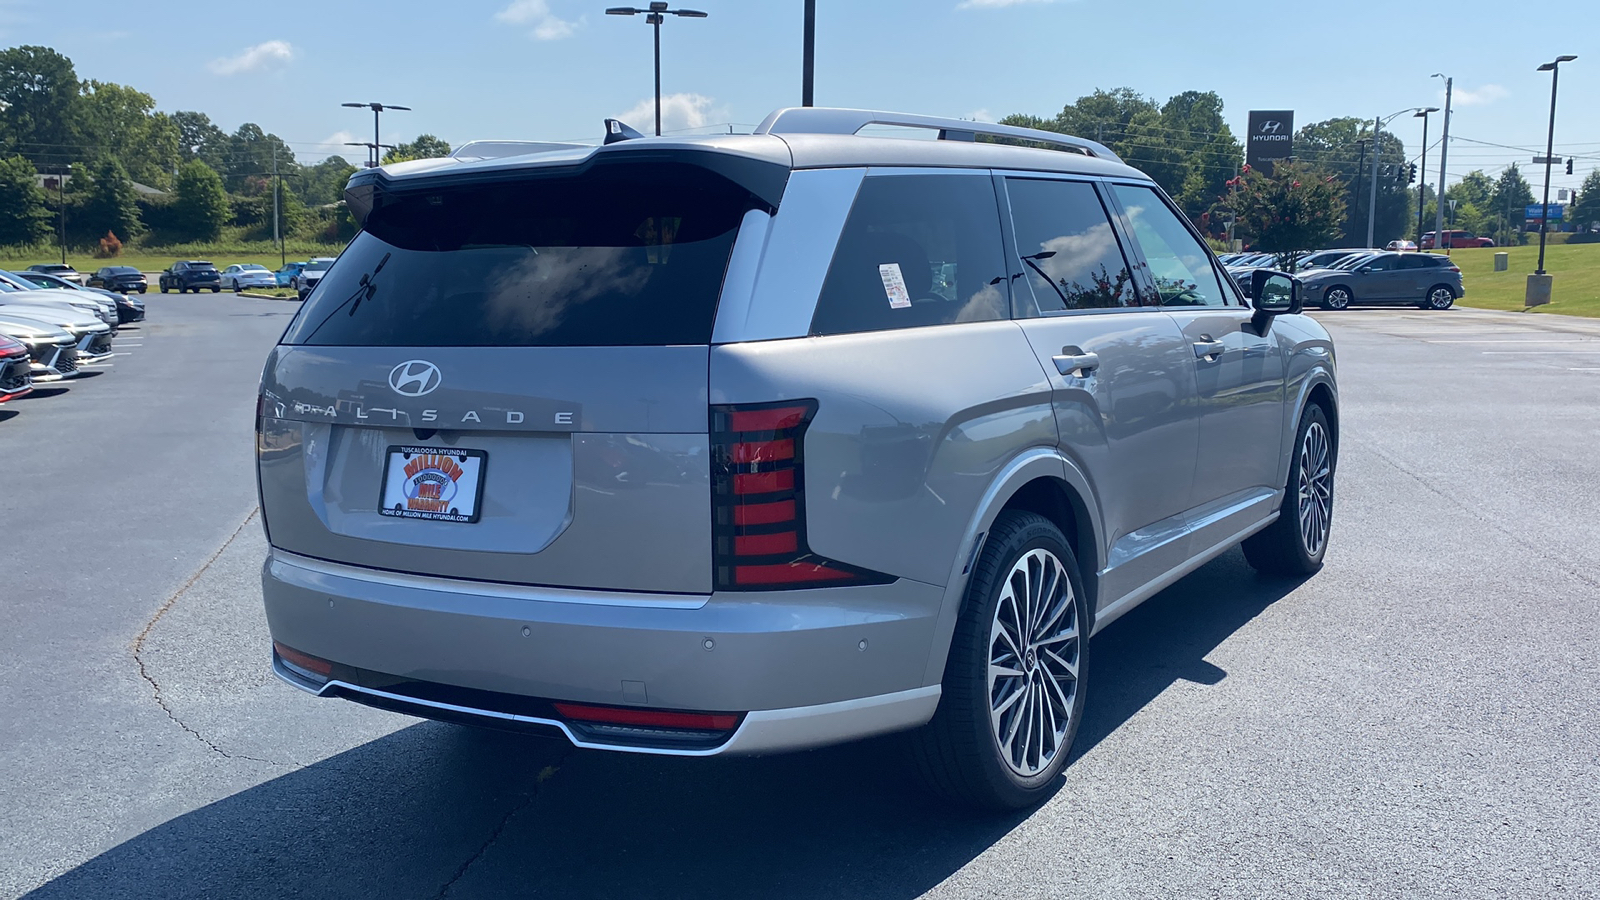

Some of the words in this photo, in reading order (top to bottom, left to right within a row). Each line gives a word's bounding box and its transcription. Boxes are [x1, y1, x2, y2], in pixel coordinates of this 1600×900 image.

[300, 403, 573, 425] PALISADE
[403, 454, 464, 483] MILLION
[419, 484, 441, 498] MILE
[407, 498, 450, 512] WARRANTY
[432, 513, 469, 522] HYUNDAI.COM
